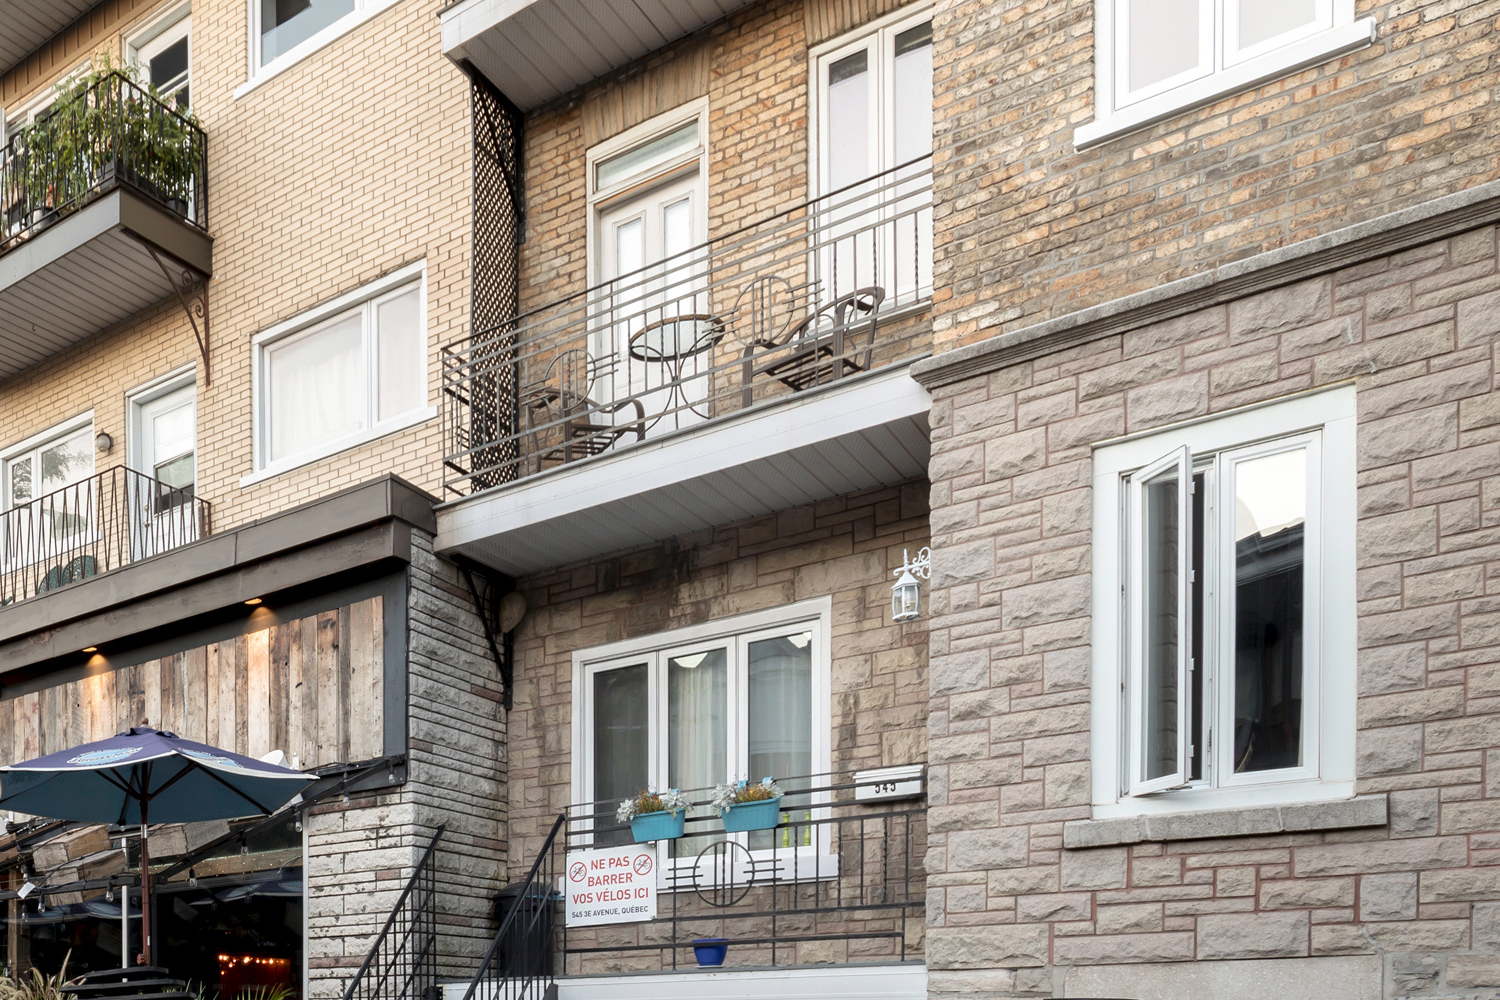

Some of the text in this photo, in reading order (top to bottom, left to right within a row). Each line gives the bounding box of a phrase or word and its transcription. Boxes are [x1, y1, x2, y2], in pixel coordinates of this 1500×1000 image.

[590, 856, 630, 870] NE PAS
[587, 872, 633, 887] BARRER
[572, 887, 649, 905] VOS VÉLOS ICI
[592, 908, 620, 917] AVENUE,
[621, 905, 649, 914] QUÉBEC
